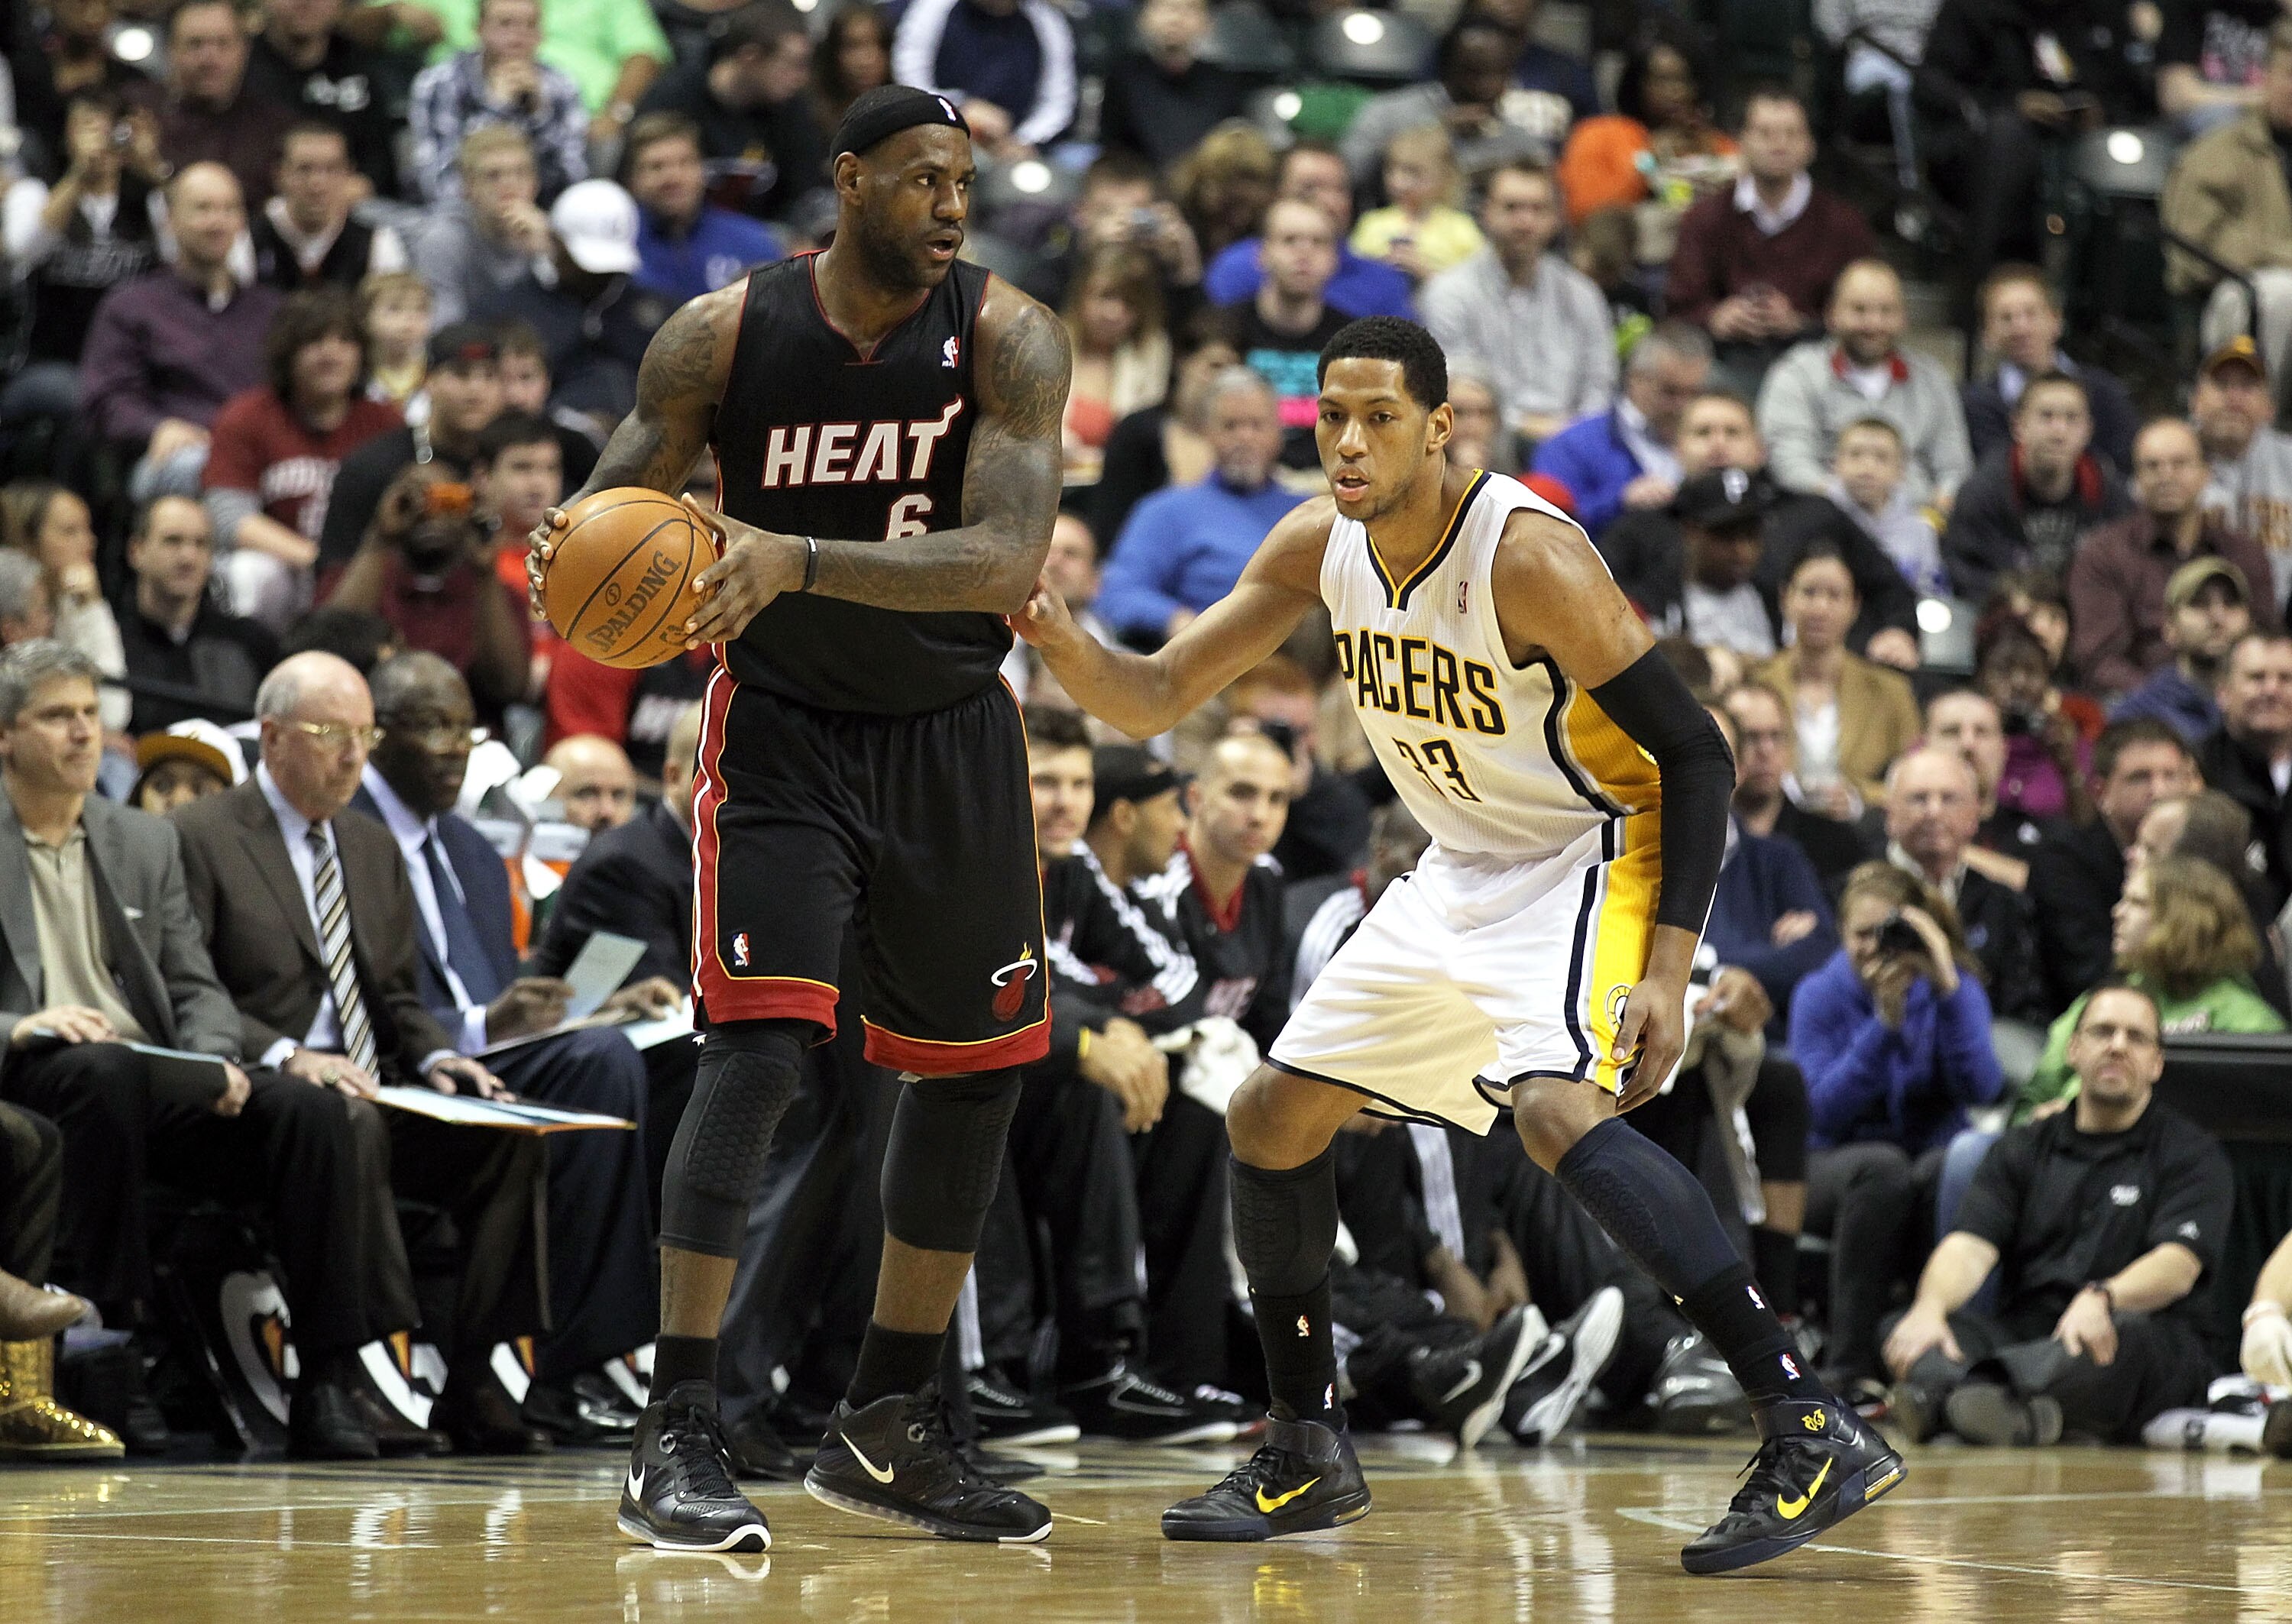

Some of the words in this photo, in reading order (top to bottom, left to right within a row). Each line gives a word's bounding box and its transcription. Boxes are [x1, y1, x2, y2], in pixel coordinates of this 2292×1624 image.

[761, 394, 964, 489] HEAT
[882, 492, 935, 542] 6
[586, 550, 682, 652] SPALDING
[1334, 627, 1508, 735] PACERS
